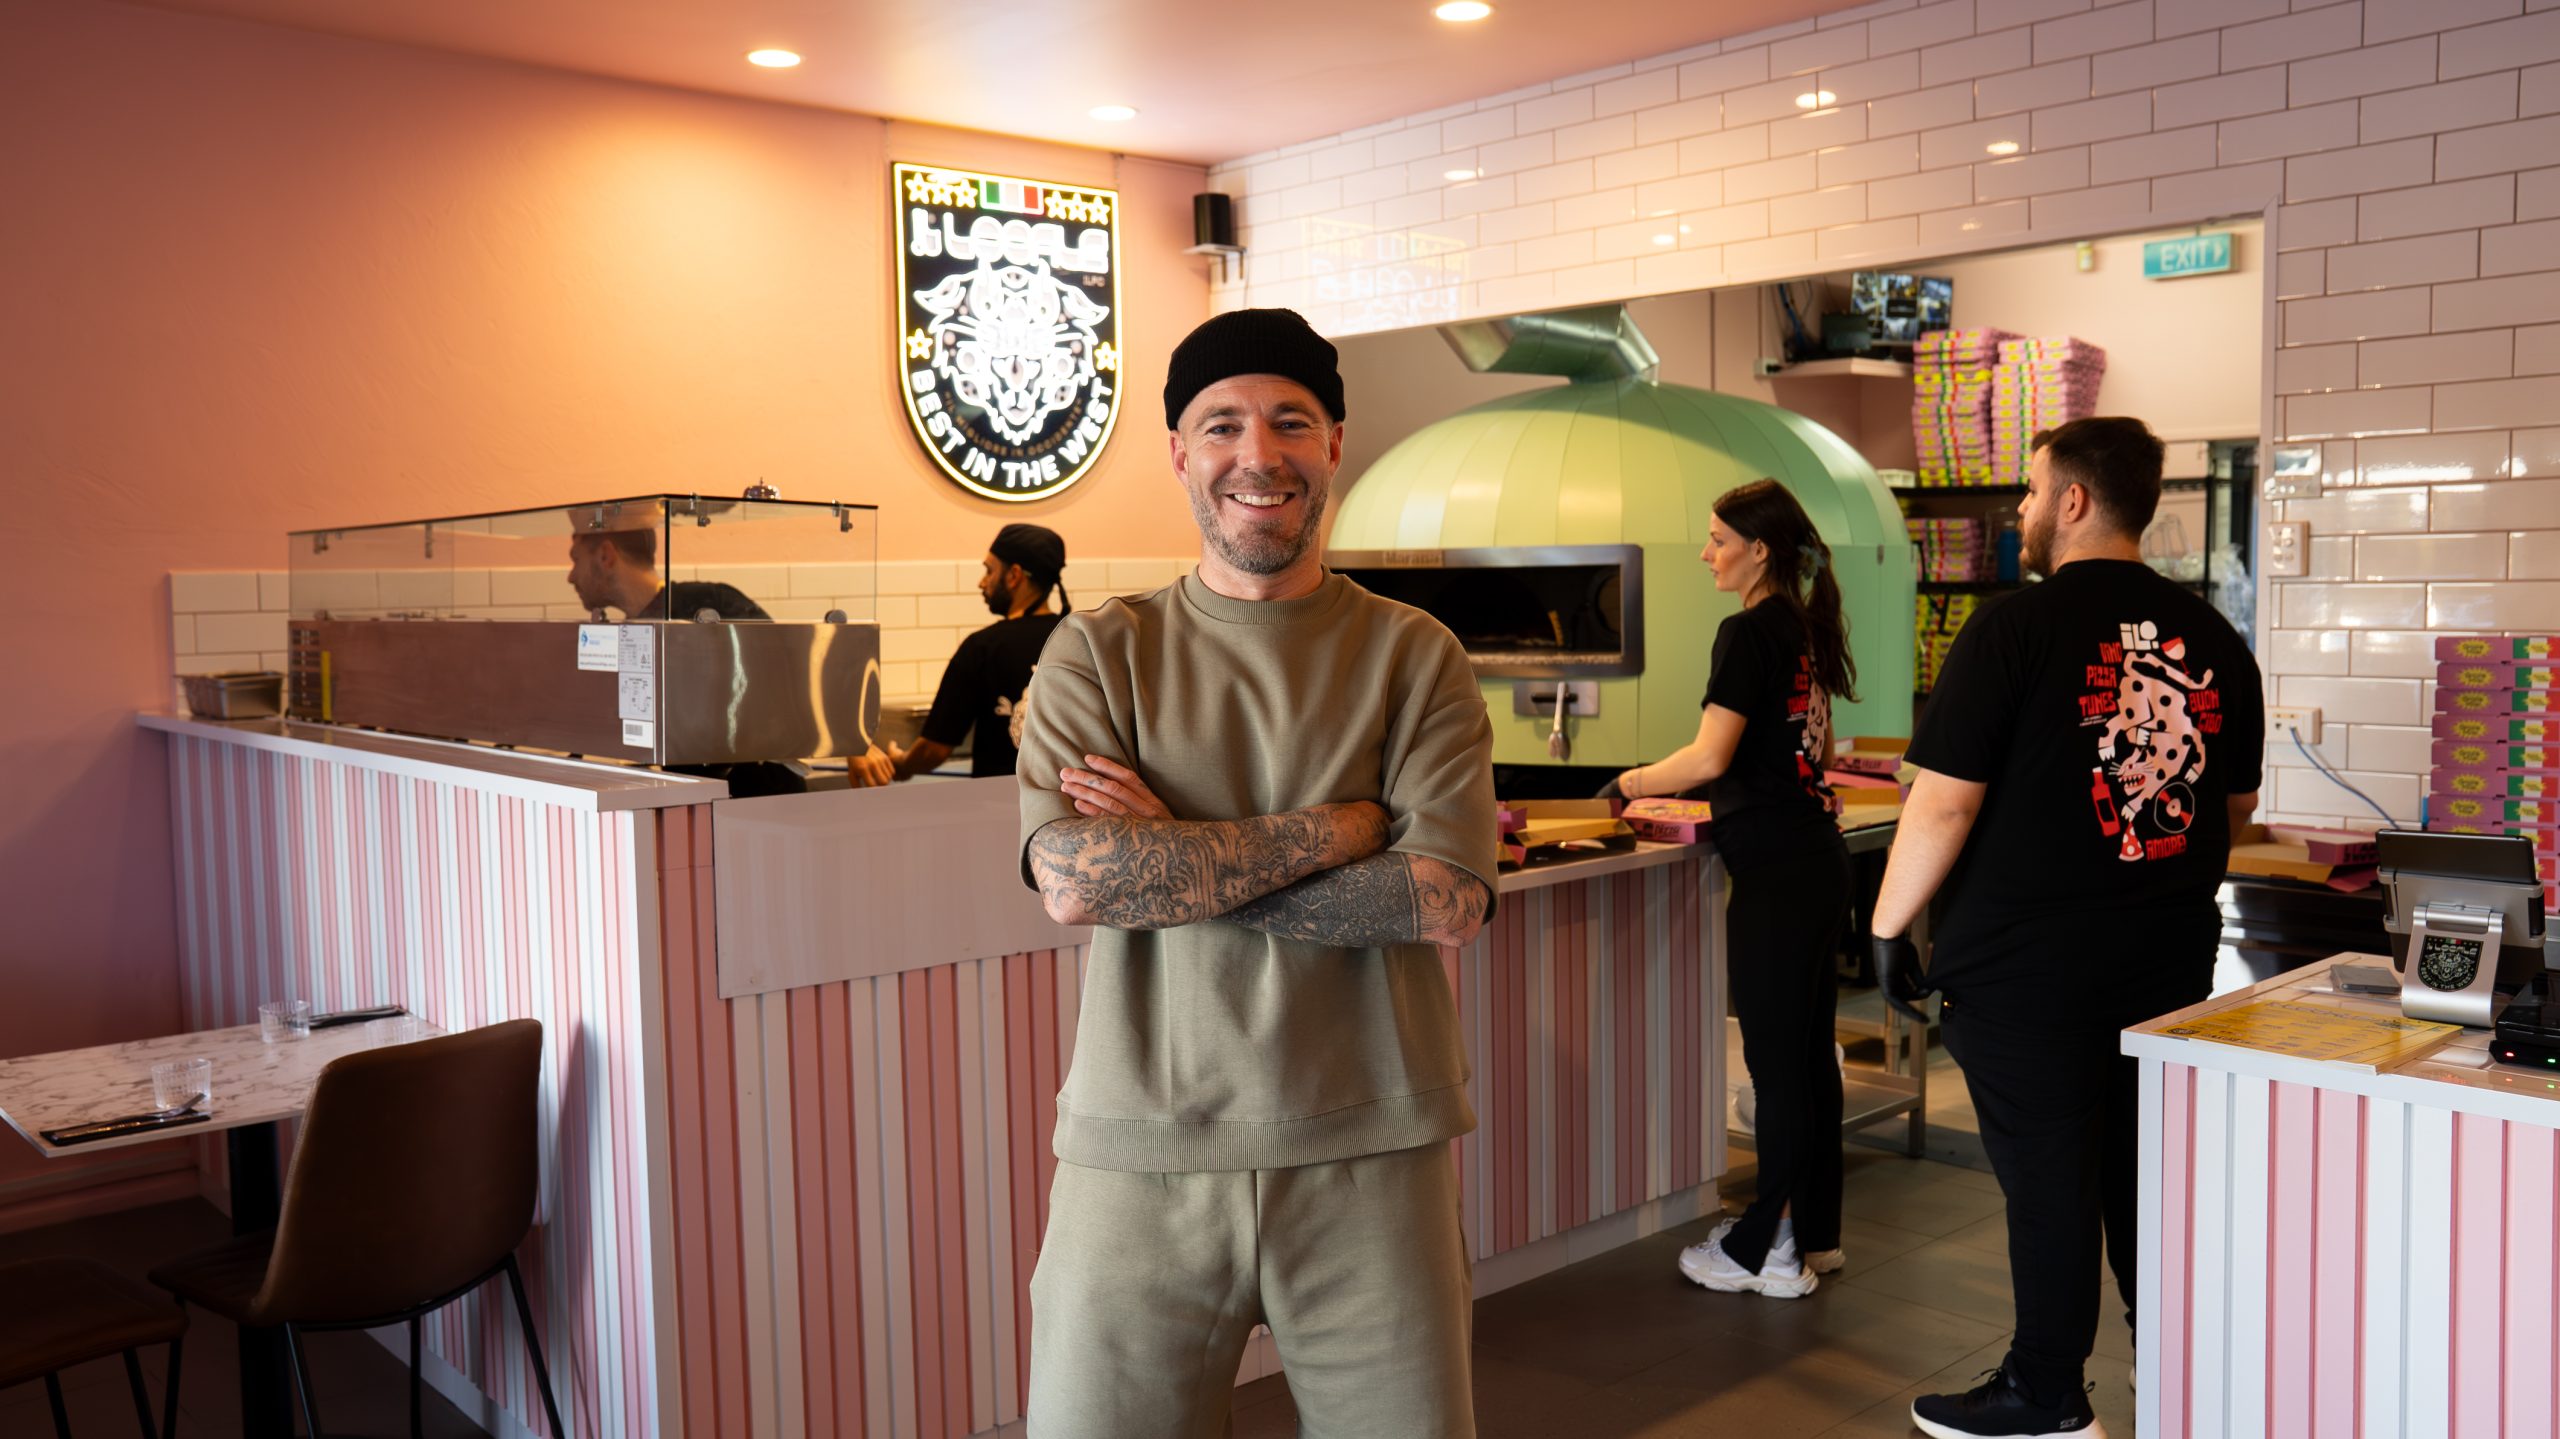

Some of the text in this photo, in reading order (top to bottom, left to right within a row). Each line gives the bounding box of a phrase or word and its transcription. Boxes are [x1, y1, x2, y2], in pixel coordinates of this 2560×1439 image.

[2160, 239, 2209, 271] EXIT
[911, 369, 1113, 488] BEST IN THE WEST
[2078, 691, 2117, 717] TUNES
[2189, 688, 2220, 713] BUON
